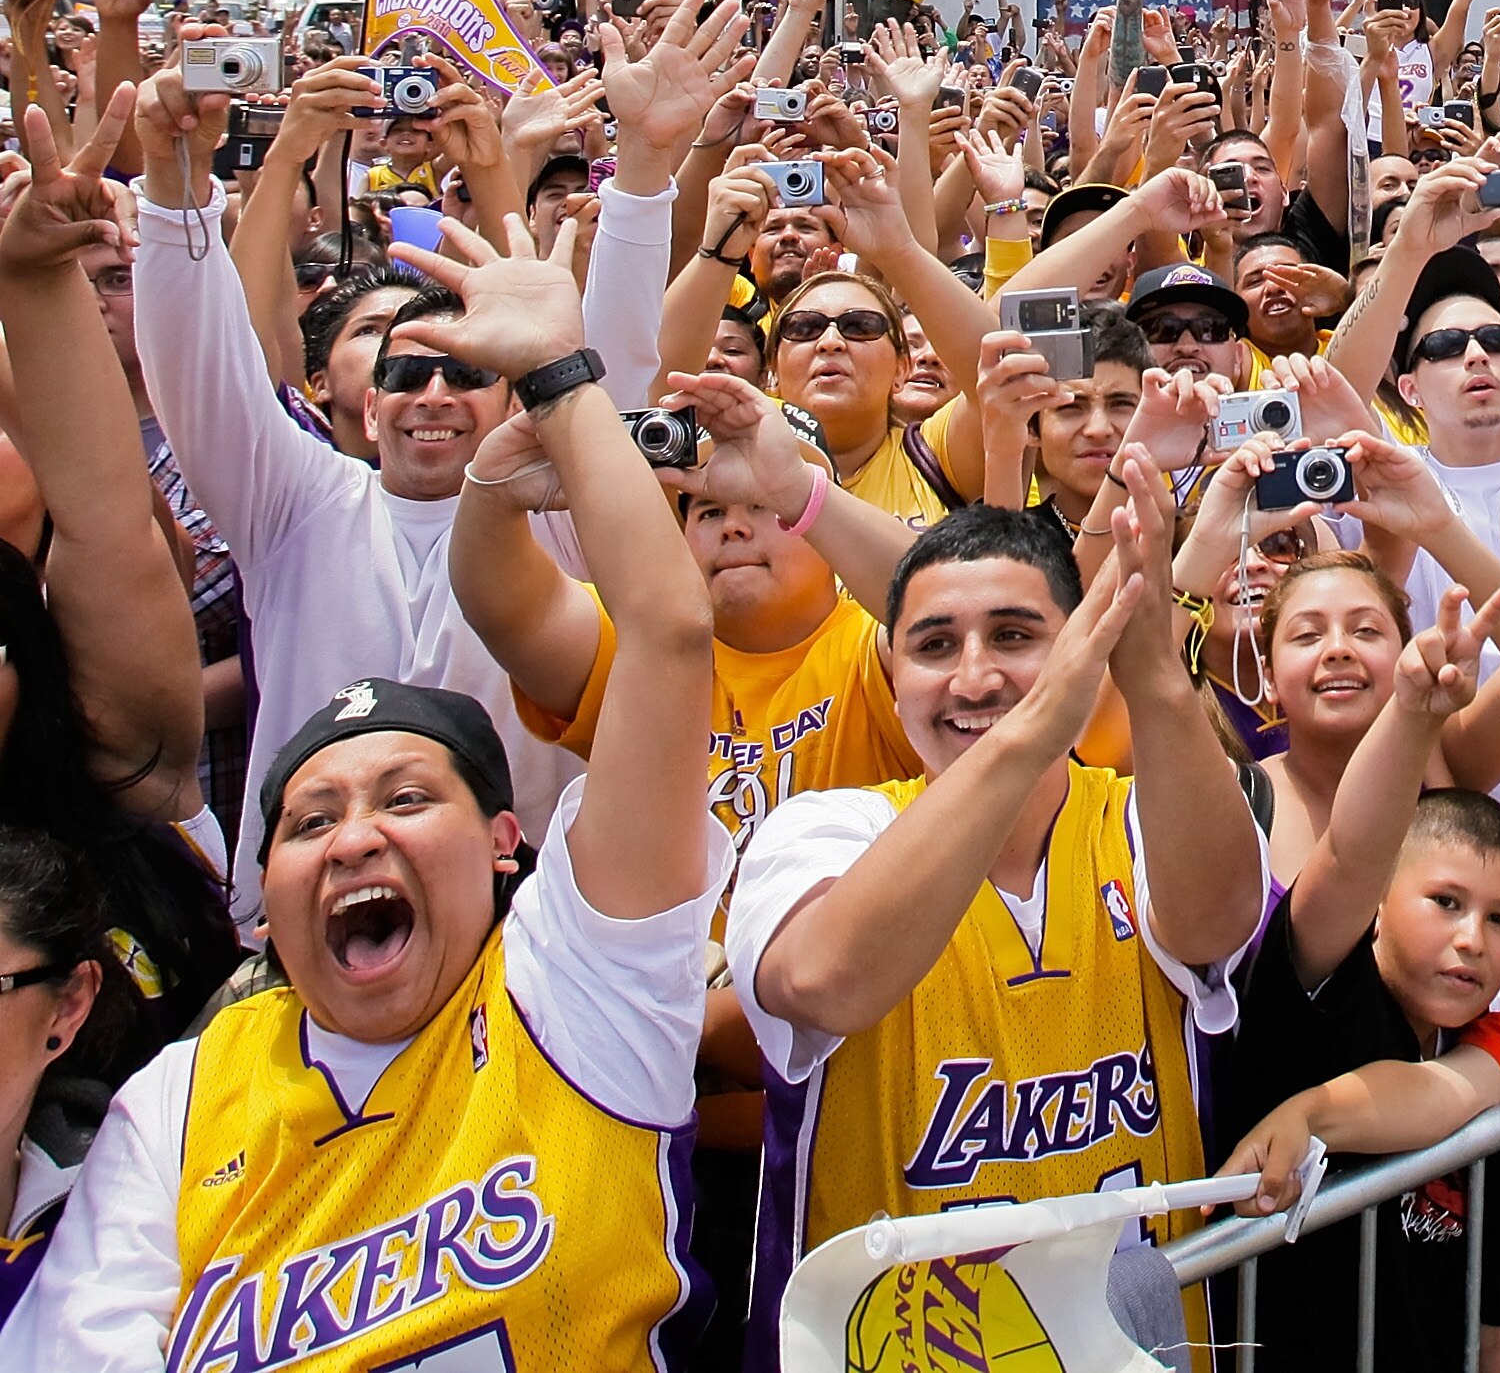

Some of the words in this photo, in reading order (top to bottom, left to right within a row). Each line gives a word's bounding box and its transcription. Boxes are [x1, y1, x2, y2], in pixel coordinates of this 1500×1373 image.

[426, 15, 452, 38] 2010
[1399, 63, 1428, 79] ERS
[770, 696, 836, 753] DAY
[1114, 924, 1133, 938] NBA
[903, 1040, 1161, 1190] LAKERS
[165, 1153, 557, 1373] LAKERS
